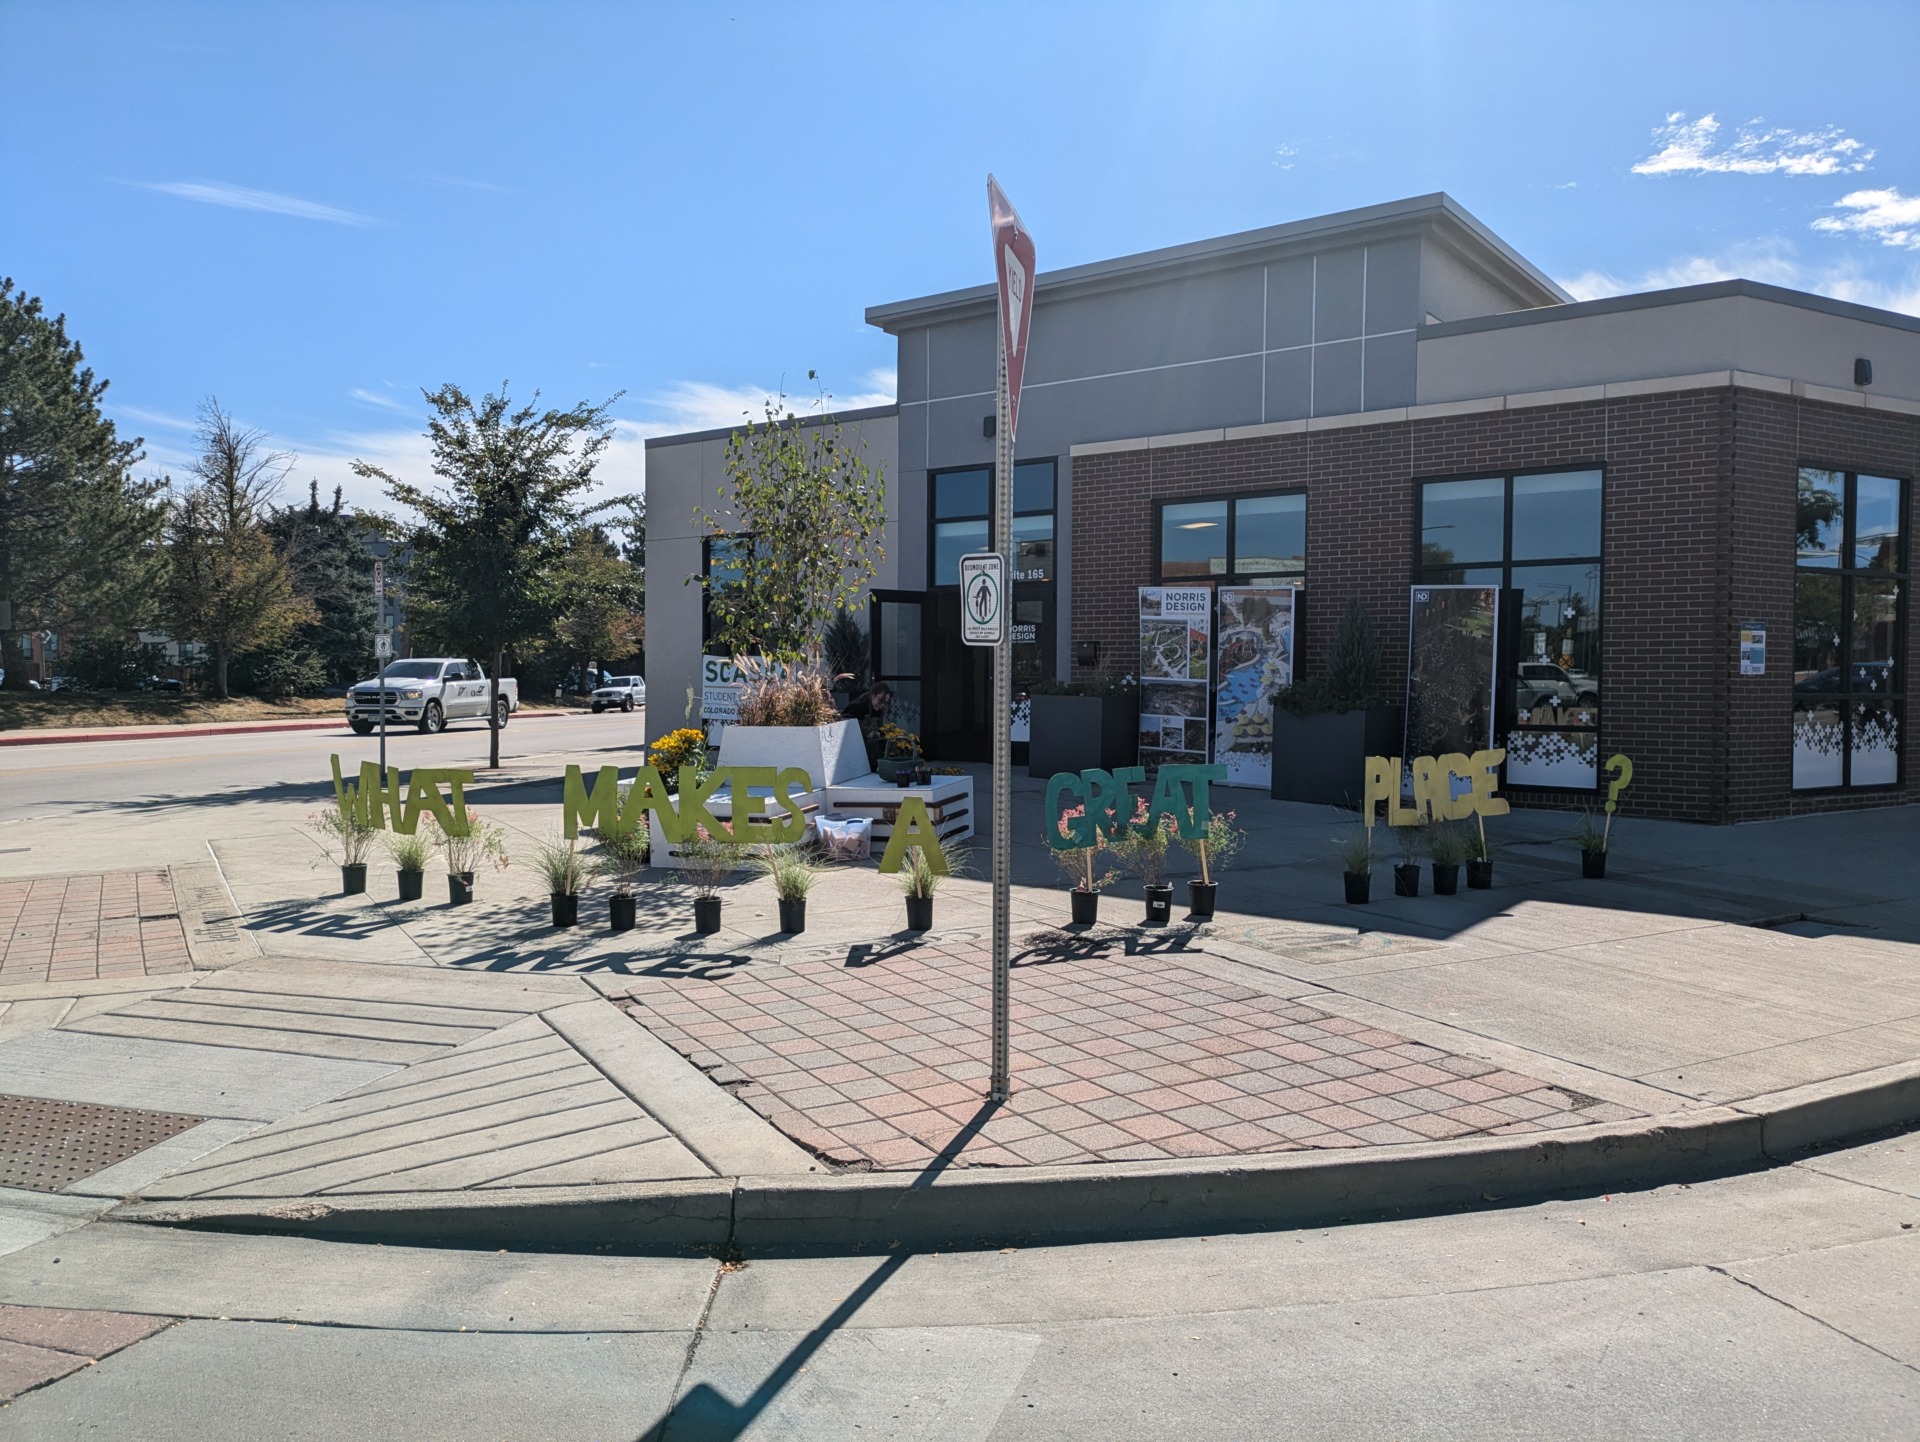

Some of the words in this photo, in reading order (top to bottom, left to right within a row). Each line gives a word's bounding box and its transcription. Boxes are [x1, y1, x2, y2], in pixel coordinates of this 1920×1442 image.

[1008, 264, 1023, 303] YIELD
[1027, 569, 1044, 579] 165
[1166, 592, 1206, 601] NORRIS
[1417, 592, 1428, 600] ND
[1166, 602, 1205, 611] DESIGN
[1012, 624, 1036, 632] ORRIS
[1012, 632, 1036, 640] ESIGN
[704, 691, 737, 701] STUDENT
[703, 706, 735, 715] COLORADO
[330, 753, 475, 837] WHAT
[563, 764, 813, 844] MAKES
[878, 796, 950, 875] A
[1045, 764, 1228, 850] GREAT
[1364, 748, 1511, 828] PLACE
[1605, 753, 1634, 814] ?
